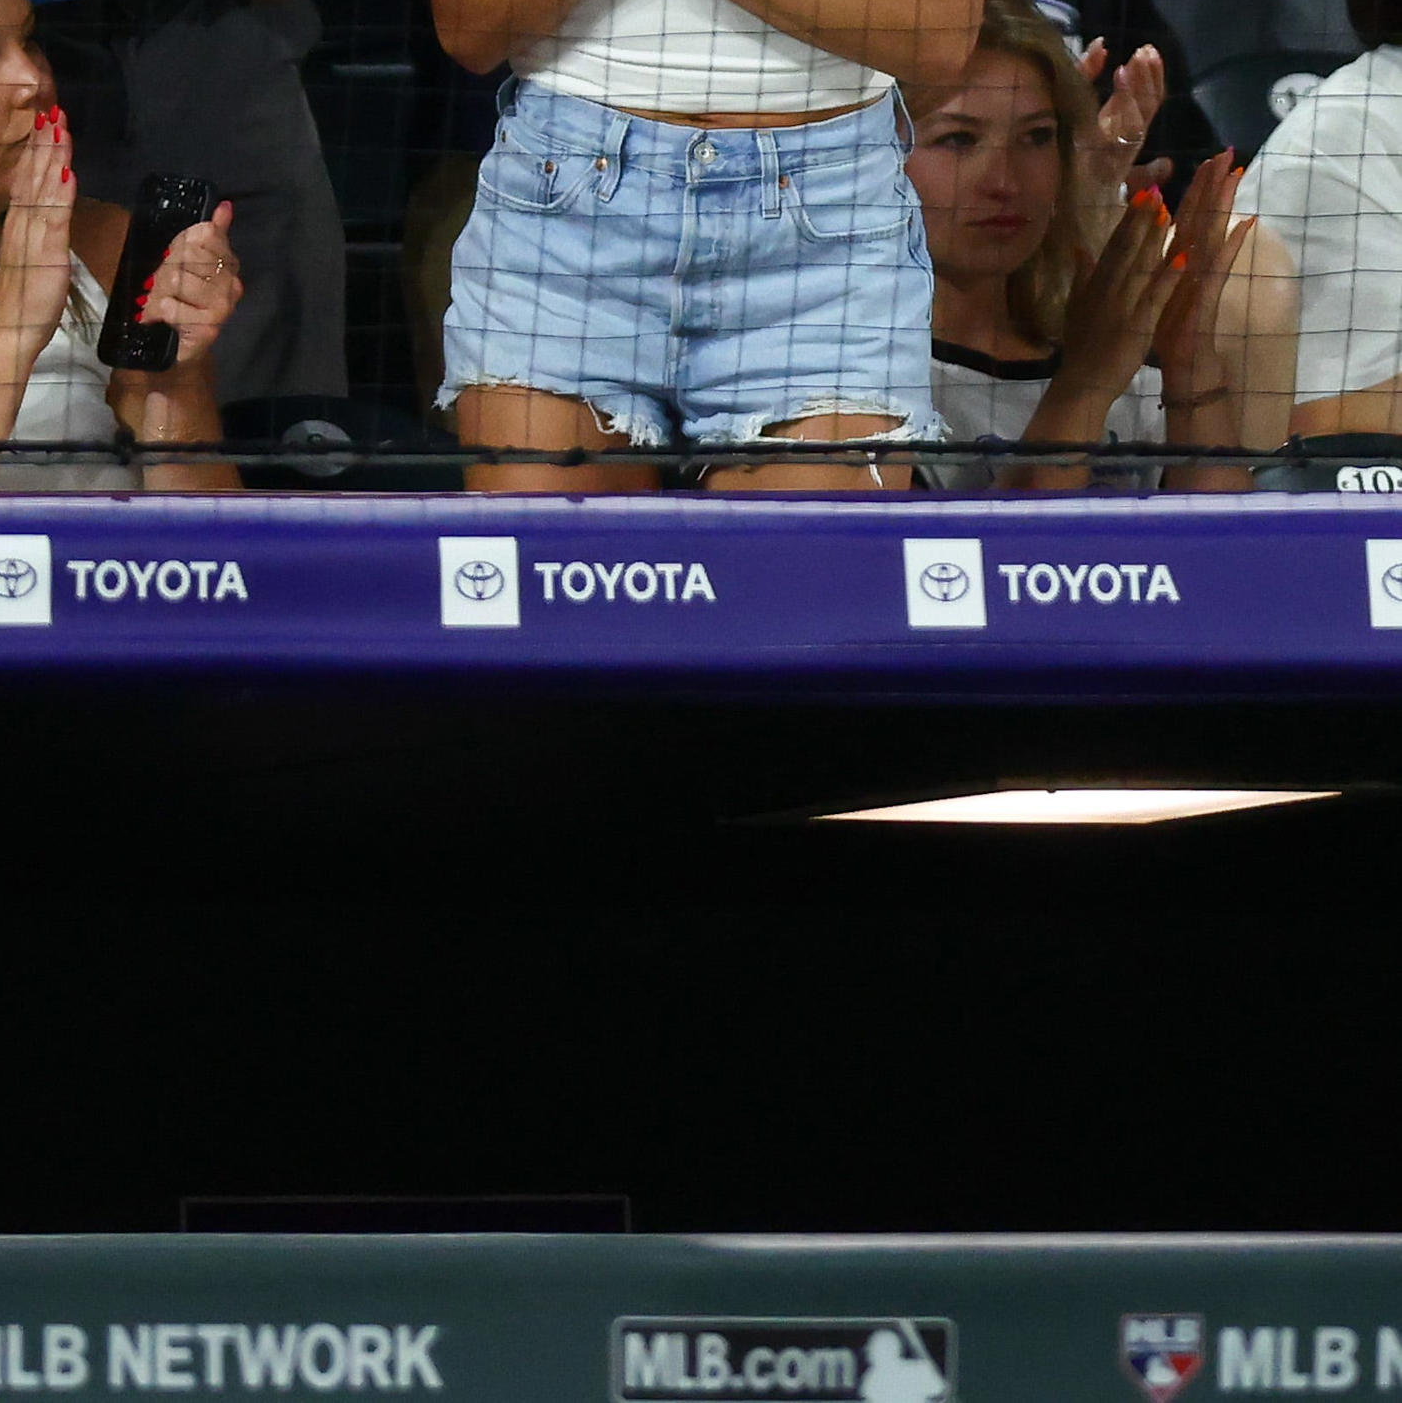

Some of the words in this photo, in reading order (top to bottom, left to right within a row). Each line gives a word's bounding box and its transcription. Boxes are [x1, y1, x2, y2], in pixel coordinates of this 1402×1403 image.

[1352, 470, 1394, 494] 10
[65, 559, 249, 601] TOYOTA
[533, 561, 717, 604] TOYOTA
[997, 563, 1182, 605] TOYOTA
[107, 1322, 444, 1391] NETWORK
[623, 1331, 857, 1391] MLB.com
[1216, 1325, 1360, 1391] MLB
